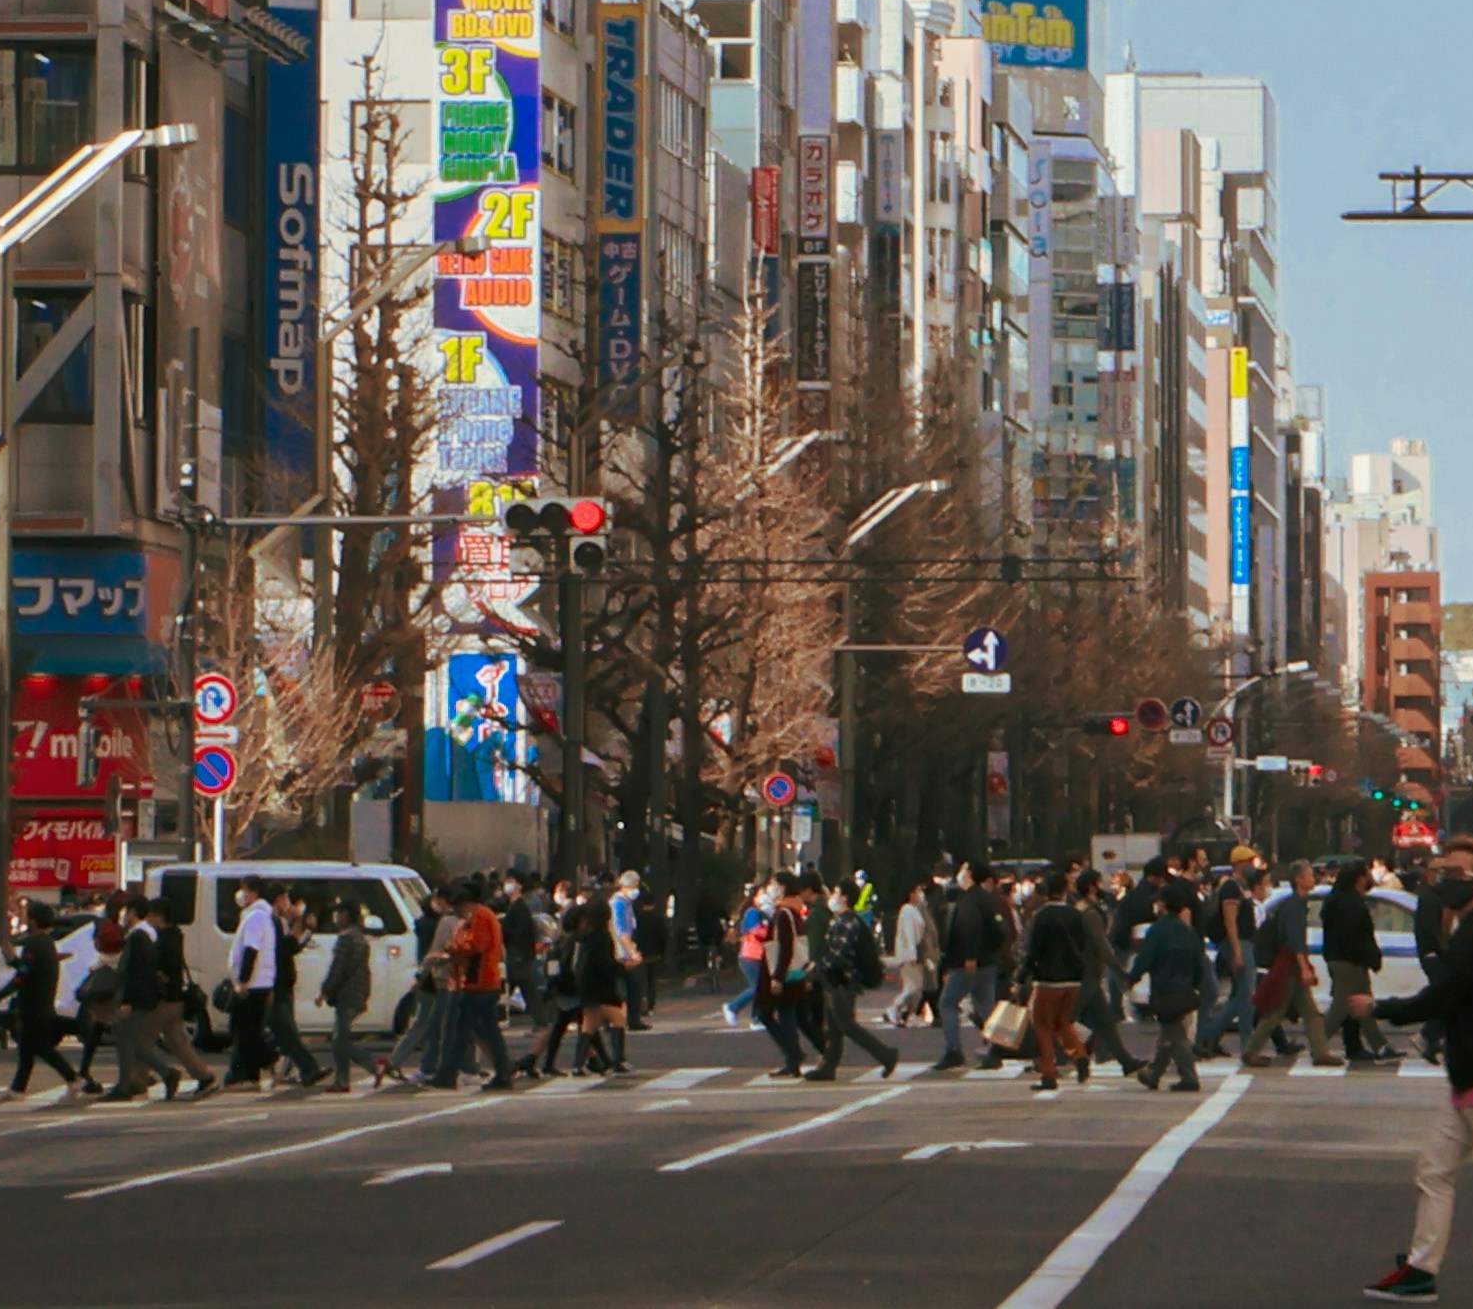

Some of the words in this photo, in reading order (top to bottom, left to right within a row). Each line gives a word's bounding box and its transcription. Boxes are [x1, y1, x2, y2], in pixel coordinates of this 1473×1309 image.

[450, 13, 534, 39] BD&DVD
[441, 48, 494, 96] 3F
[605, 14, 637, 223] TRADER
[806, 138, 825, 233] カラオケ
[483, 192, 534, 239] 2F
[269, 162, 315, 397] Sofmap
[489, 248, 533, 275] GAME
[464, 278, 532, 306] AUDIO
[439, 337, 484, 384] 1F
[24, 819, 106, 842] ワイモバイル
